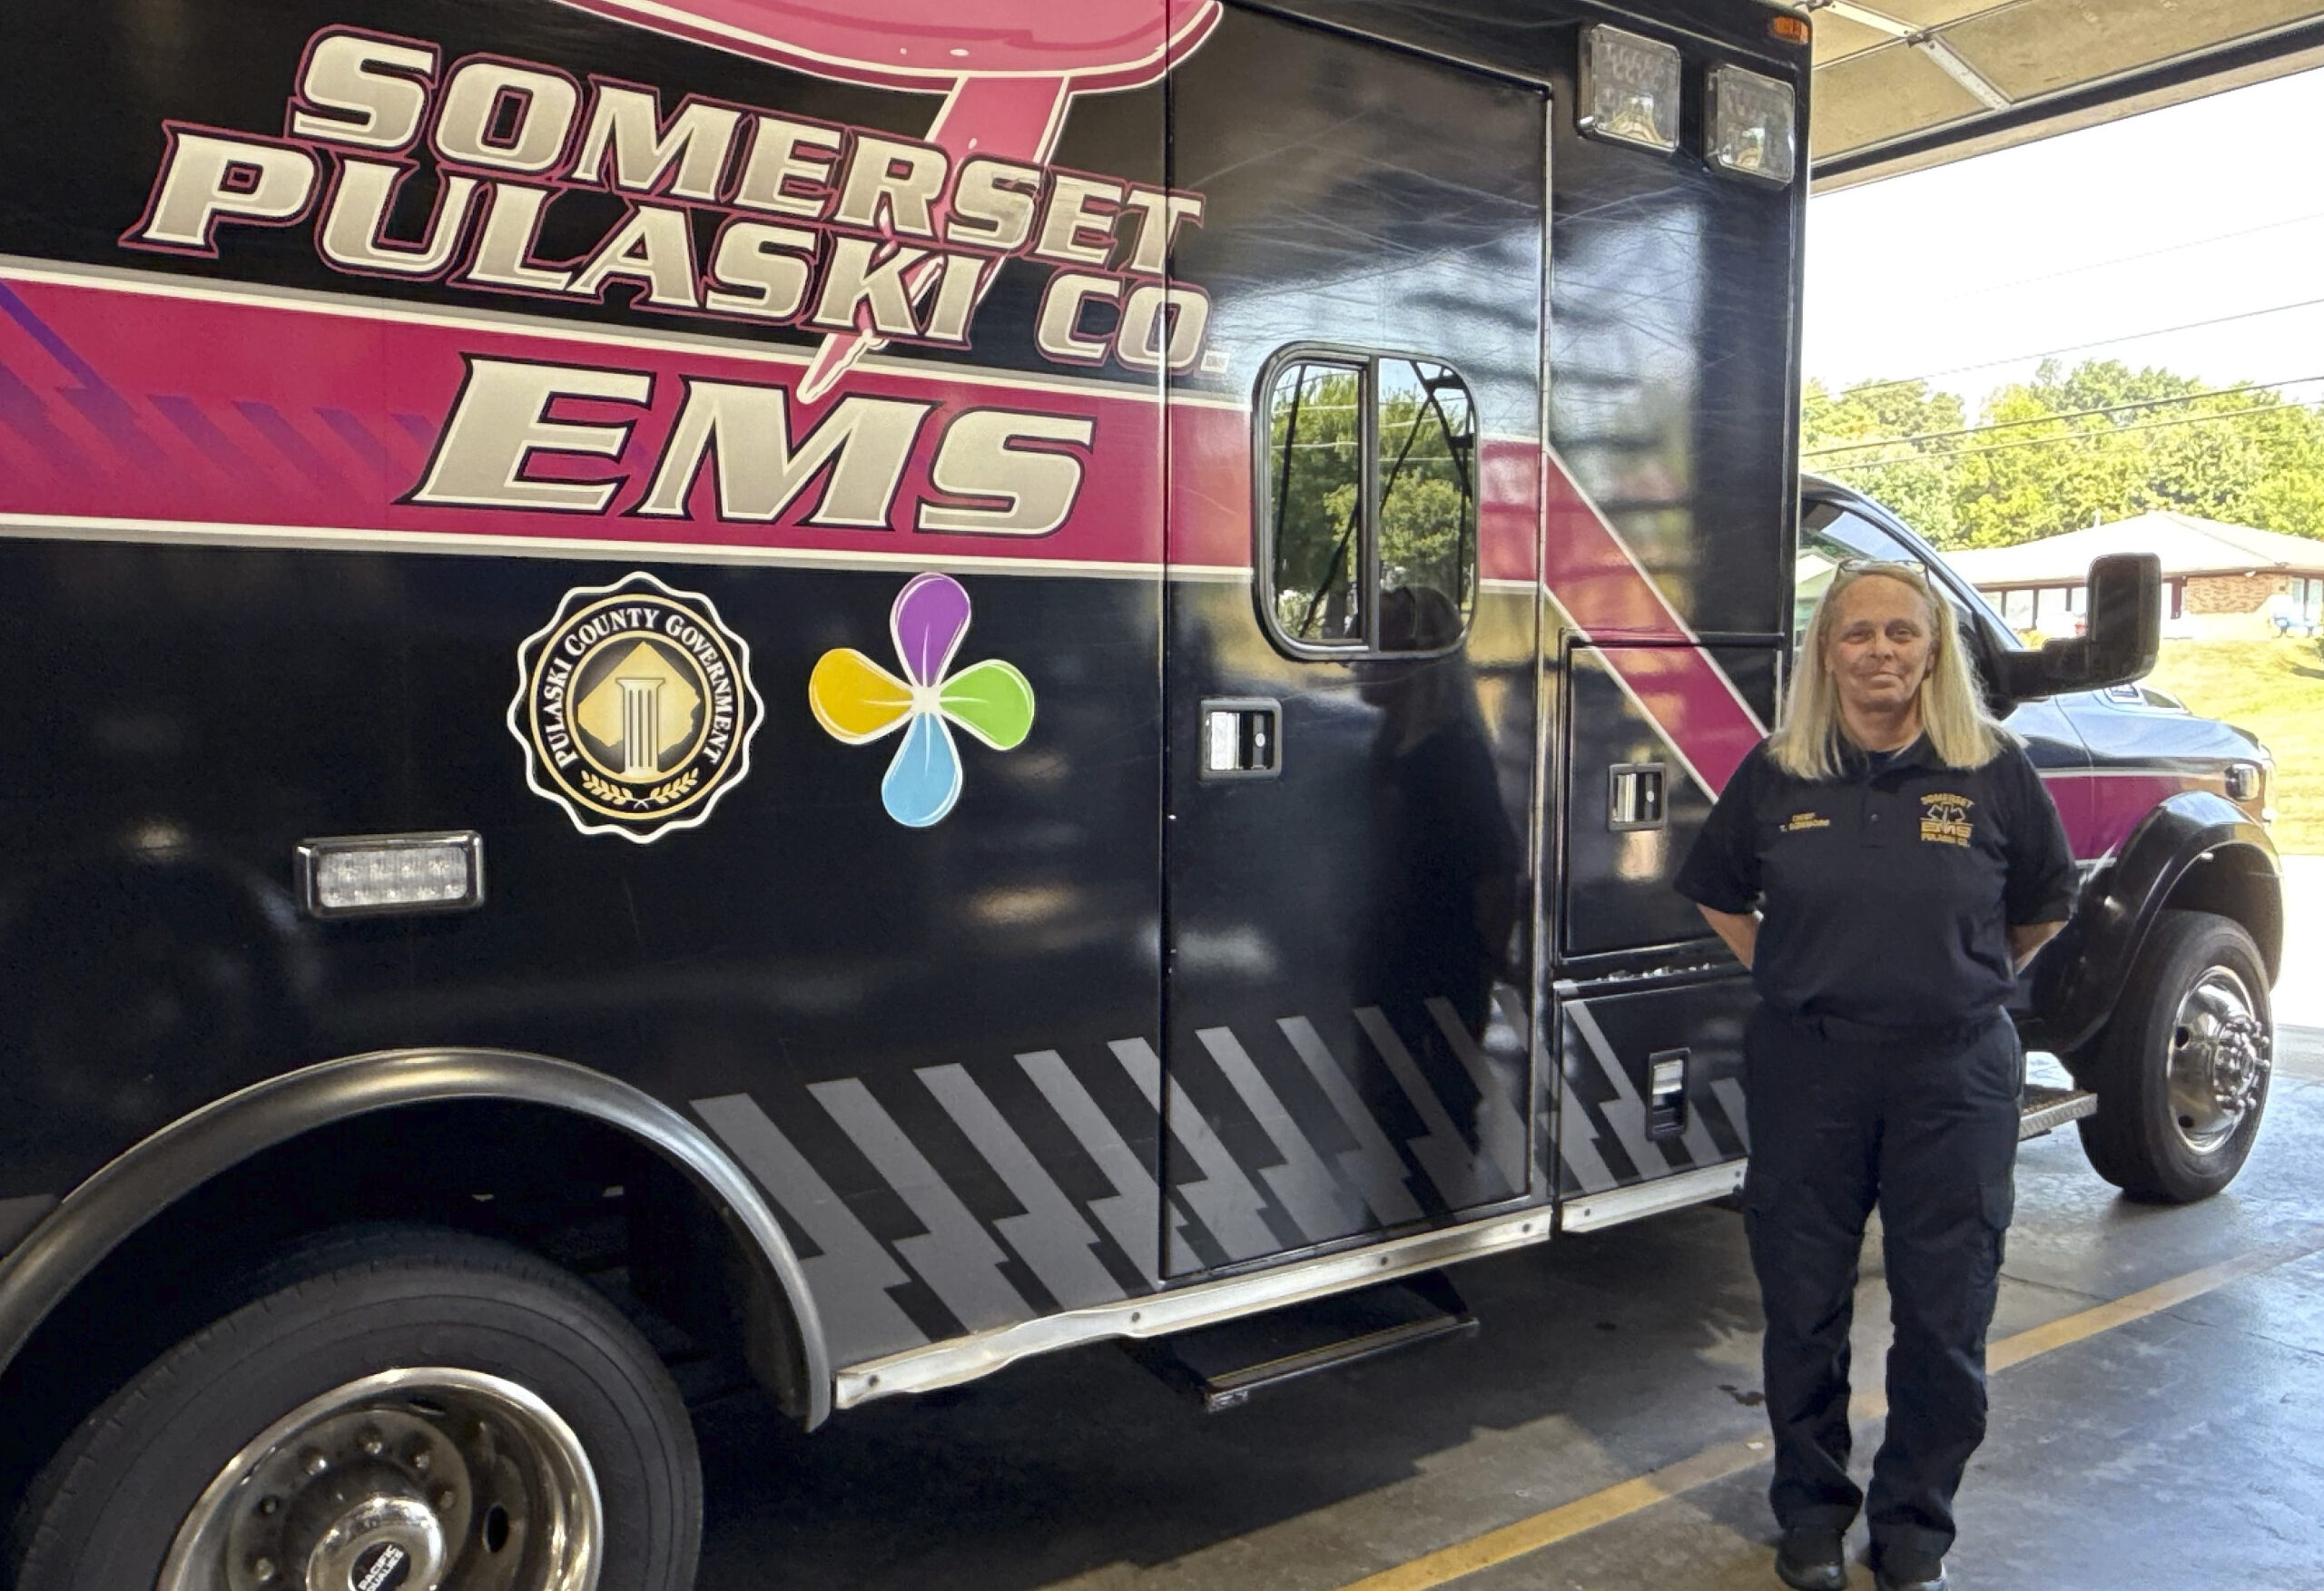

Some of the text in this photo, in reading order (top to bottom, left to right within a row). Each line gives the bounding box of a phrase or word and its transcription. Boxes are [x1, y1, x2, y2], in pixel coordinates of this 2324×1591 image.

[287, 29, 1204, 276] SOMERSET
[120, 122, 1233, 376] PULASKI CO.
[394, 352, 1097, 537] EMS
[543, 607, 734, 769] PULASKI COUNTY GOVERNMENT
[1921, 820, 1972, 839] EMS
